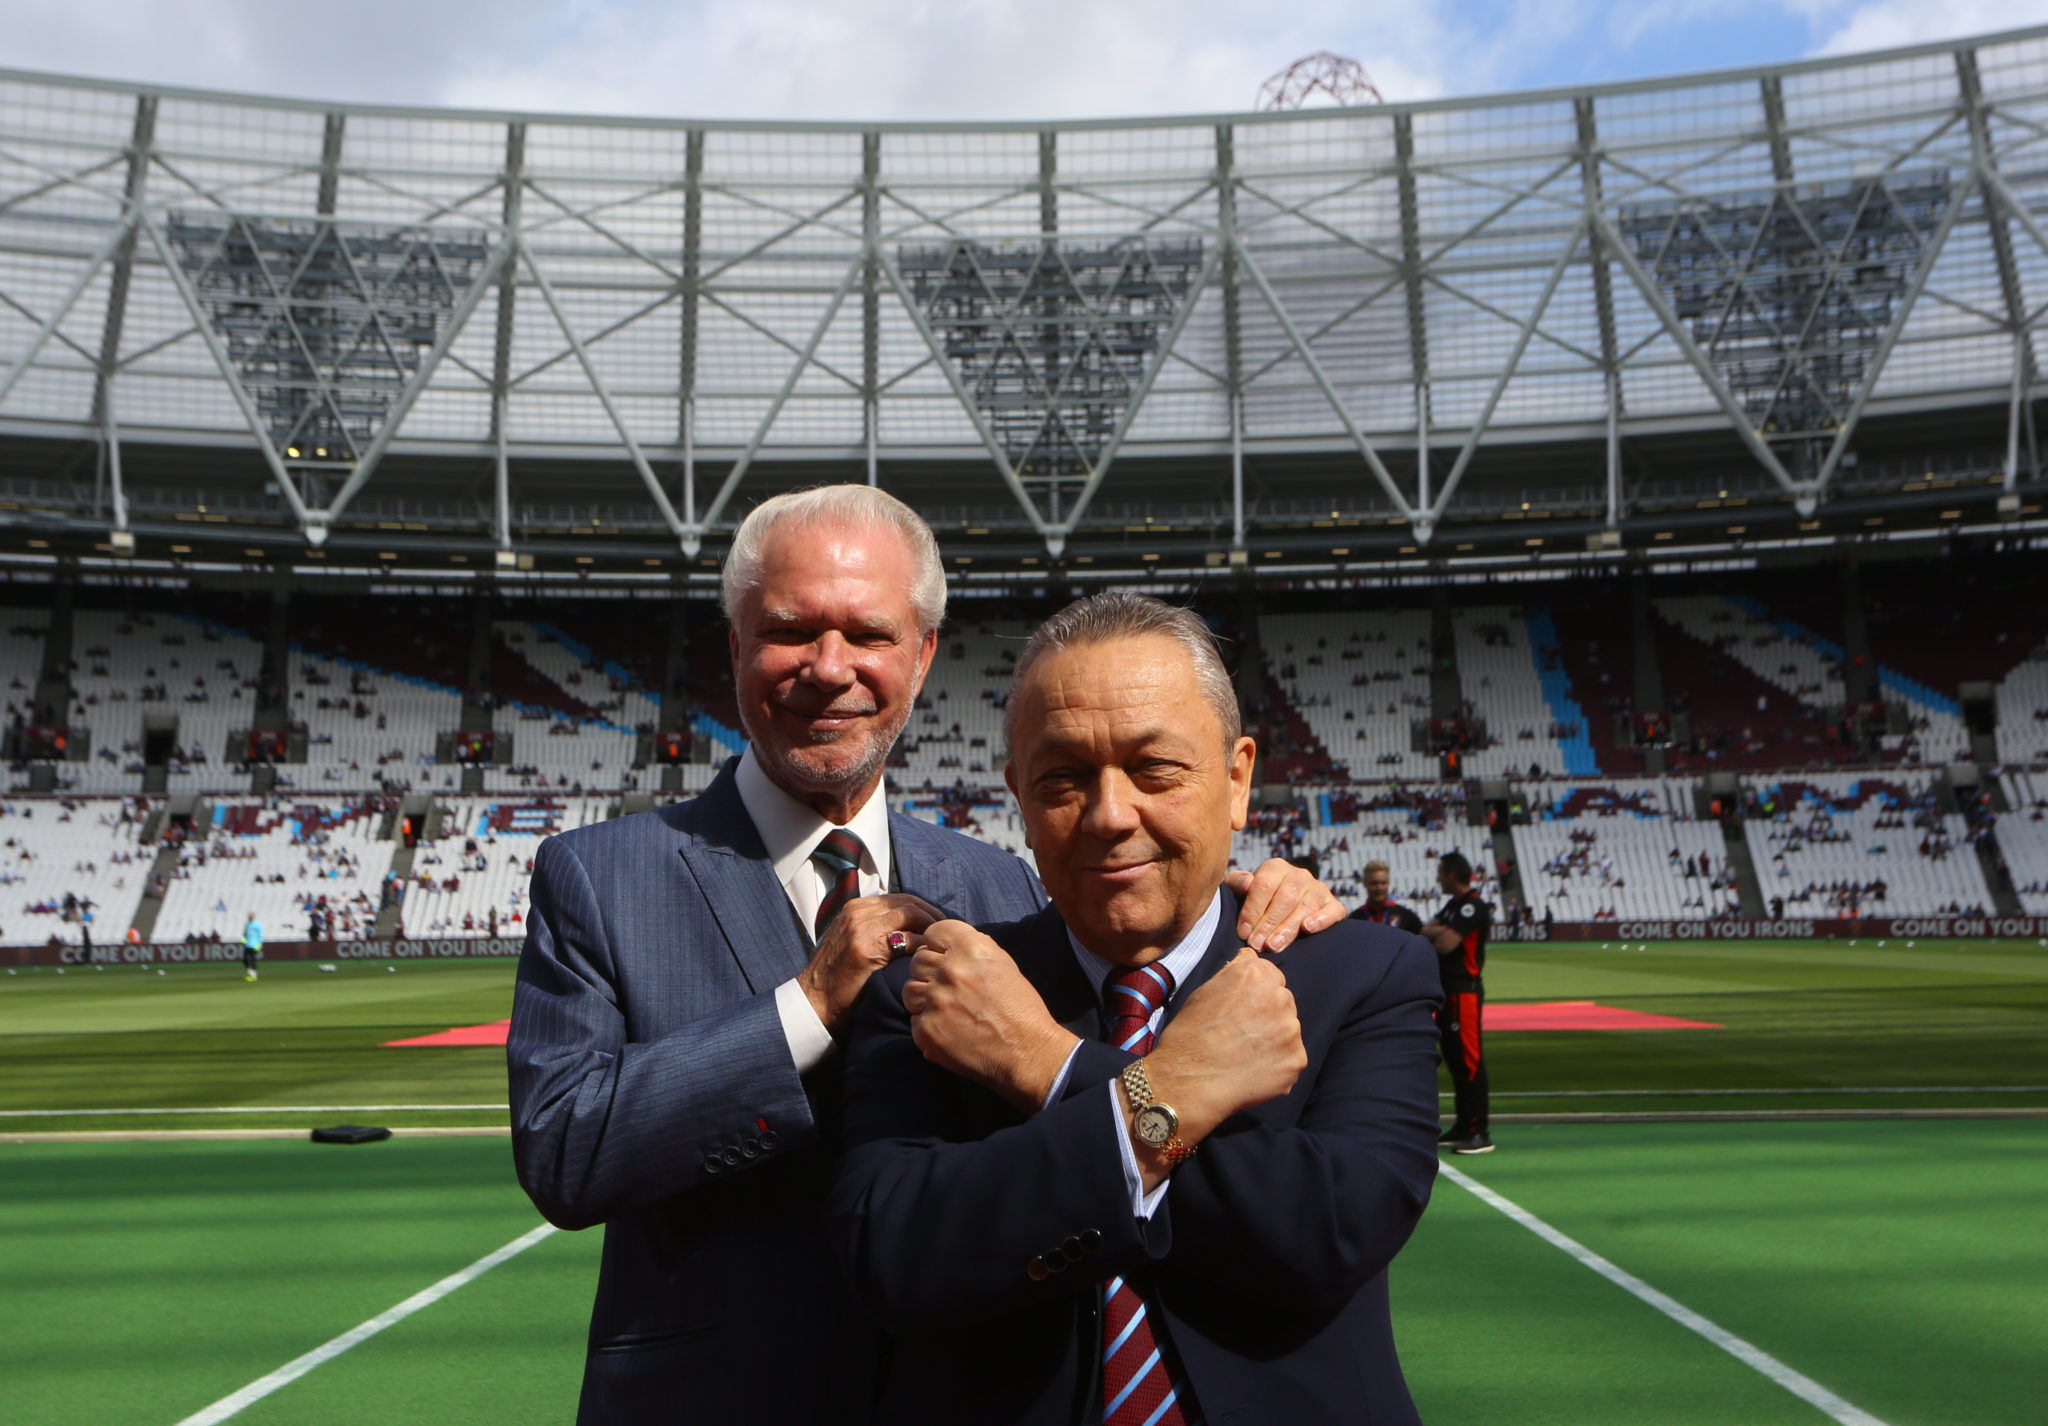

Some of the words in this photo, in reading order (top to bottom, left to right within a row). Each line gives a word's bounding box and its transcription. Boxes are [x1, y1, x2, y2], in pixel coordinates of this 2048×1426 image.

[1618, 922, 1673, 939] COME
[1676, 922, 1706, 938] ON
[1709, 922, 1751, 938] YOU
[1754, 921, 1815, 938] IRONS
[1890, 919, 1950, 937] COME
[1953, 919, 1985, 936] ON
[1988, 918, 2034, 936] YOU
[123, 945, 155, 962] ON
[156, 944, 200, 962] YOU
[336, 940, 392, 958] COME
[395, 940, 424, 957] ON
[427, 940, 466, 957] YOU
